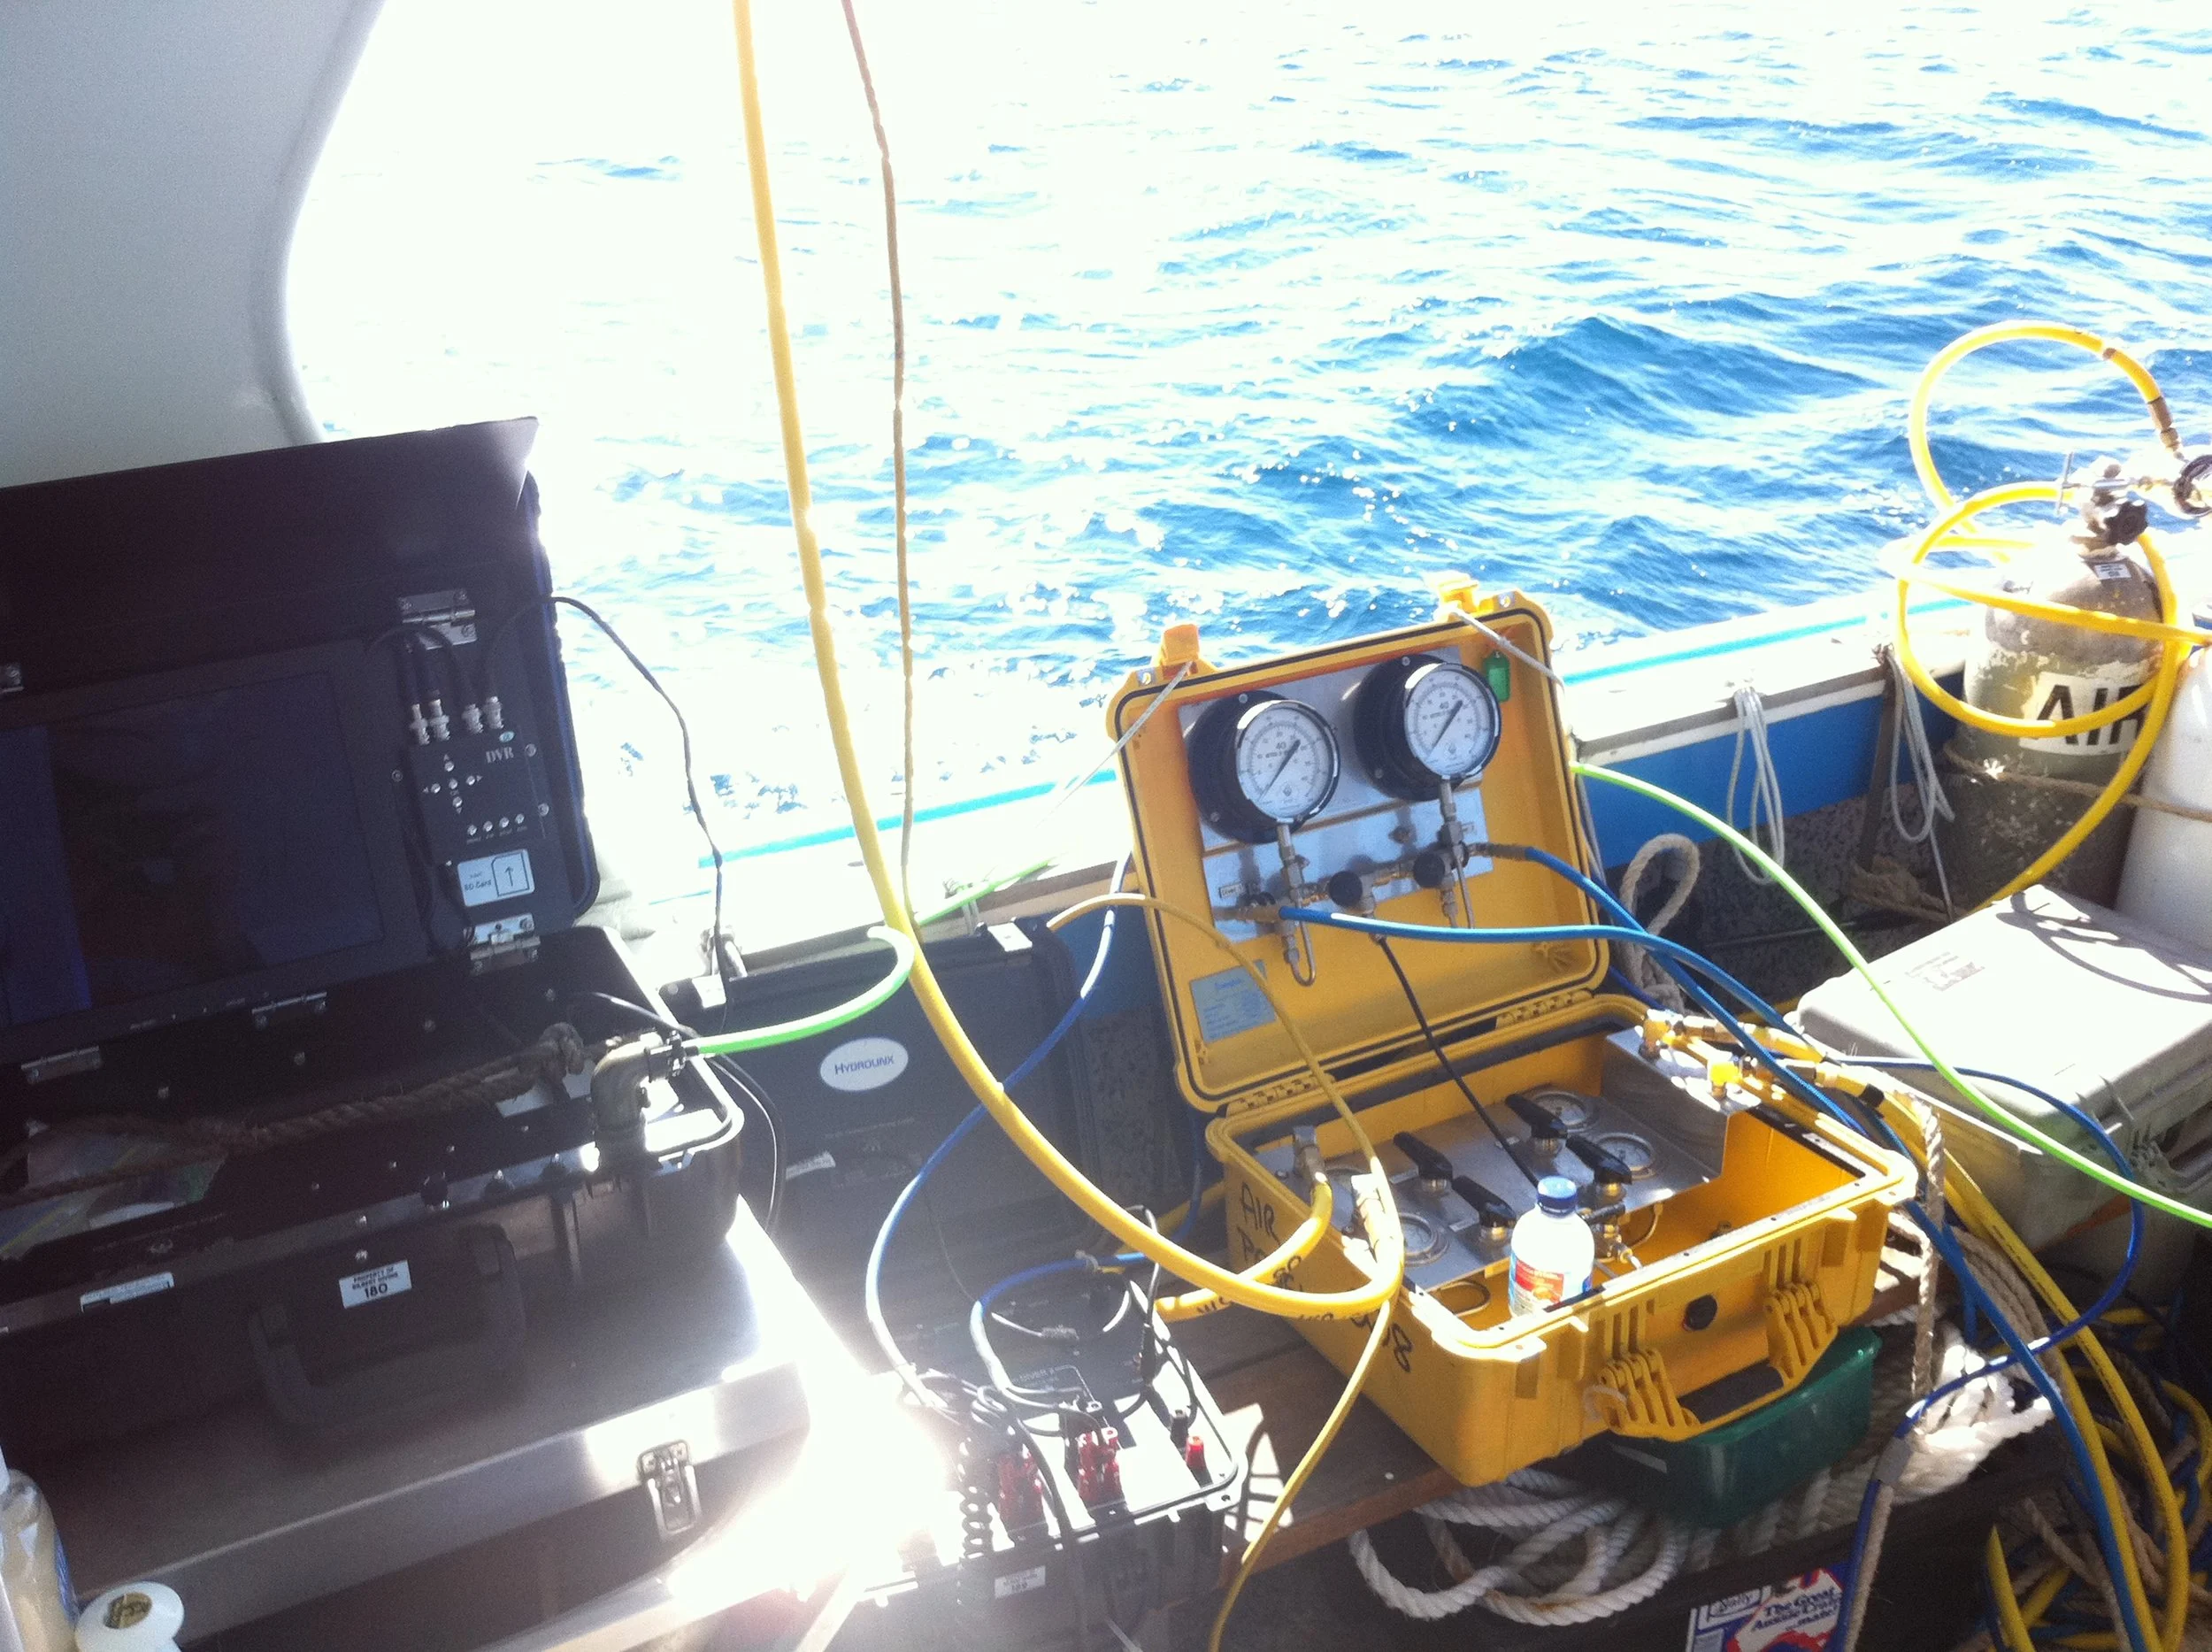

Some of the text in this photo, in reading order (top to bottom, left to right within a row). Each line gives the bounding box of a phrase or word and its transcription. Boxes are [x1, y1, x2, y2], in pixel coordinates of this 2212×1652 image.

[2037, 683, 2147, 746] AIR
[486, 746, 514, 764] DVR
[365, 1283, 388, 1298] 180
